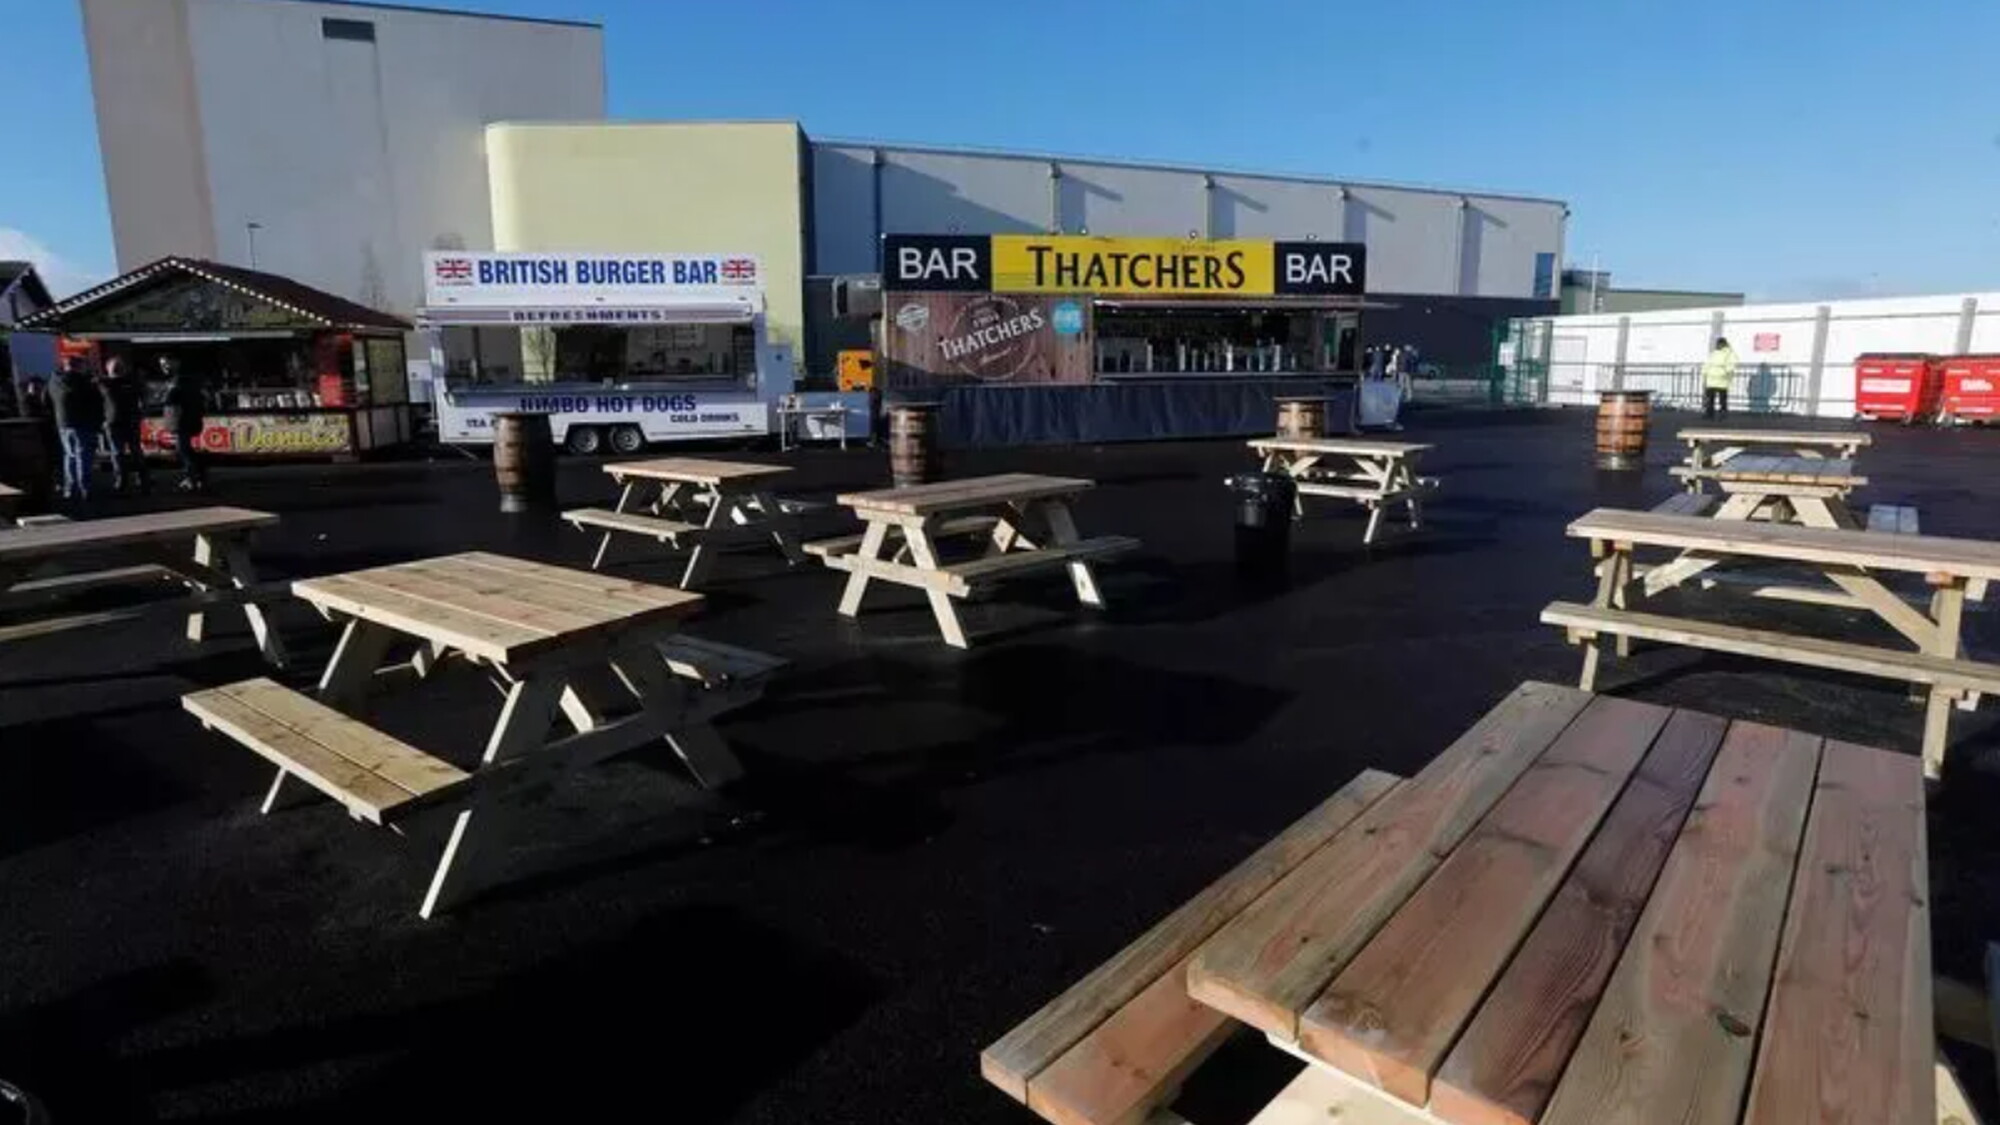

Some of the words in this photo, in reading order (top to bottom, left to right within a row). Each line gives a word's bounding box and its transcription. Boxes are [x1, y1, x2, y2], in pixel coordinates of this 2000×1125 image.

[478, 259, 568, 284] BRITISH
[576, 259, 666, 284] BURGER
[673, 259, 718, 284] BAR
[899, 247, 978, 279] BAR
[1026, 245, 1246, 289] THATCHERS
[1286, 254, 1354, 284] BAR
[513, 309, 662, 321] REFRESHMENTS
[937, 308, 1046, 361] THATCHERS
[519, 395, 589, 413] JUMBO
[597, 395, 637, 413] HOT
[642, 394, 697, 412] DOGS
[466, 418, 487, 428] TEA
[669, 413, 698, 423] COLD
[700, 412, 740, 423] DRINKS
